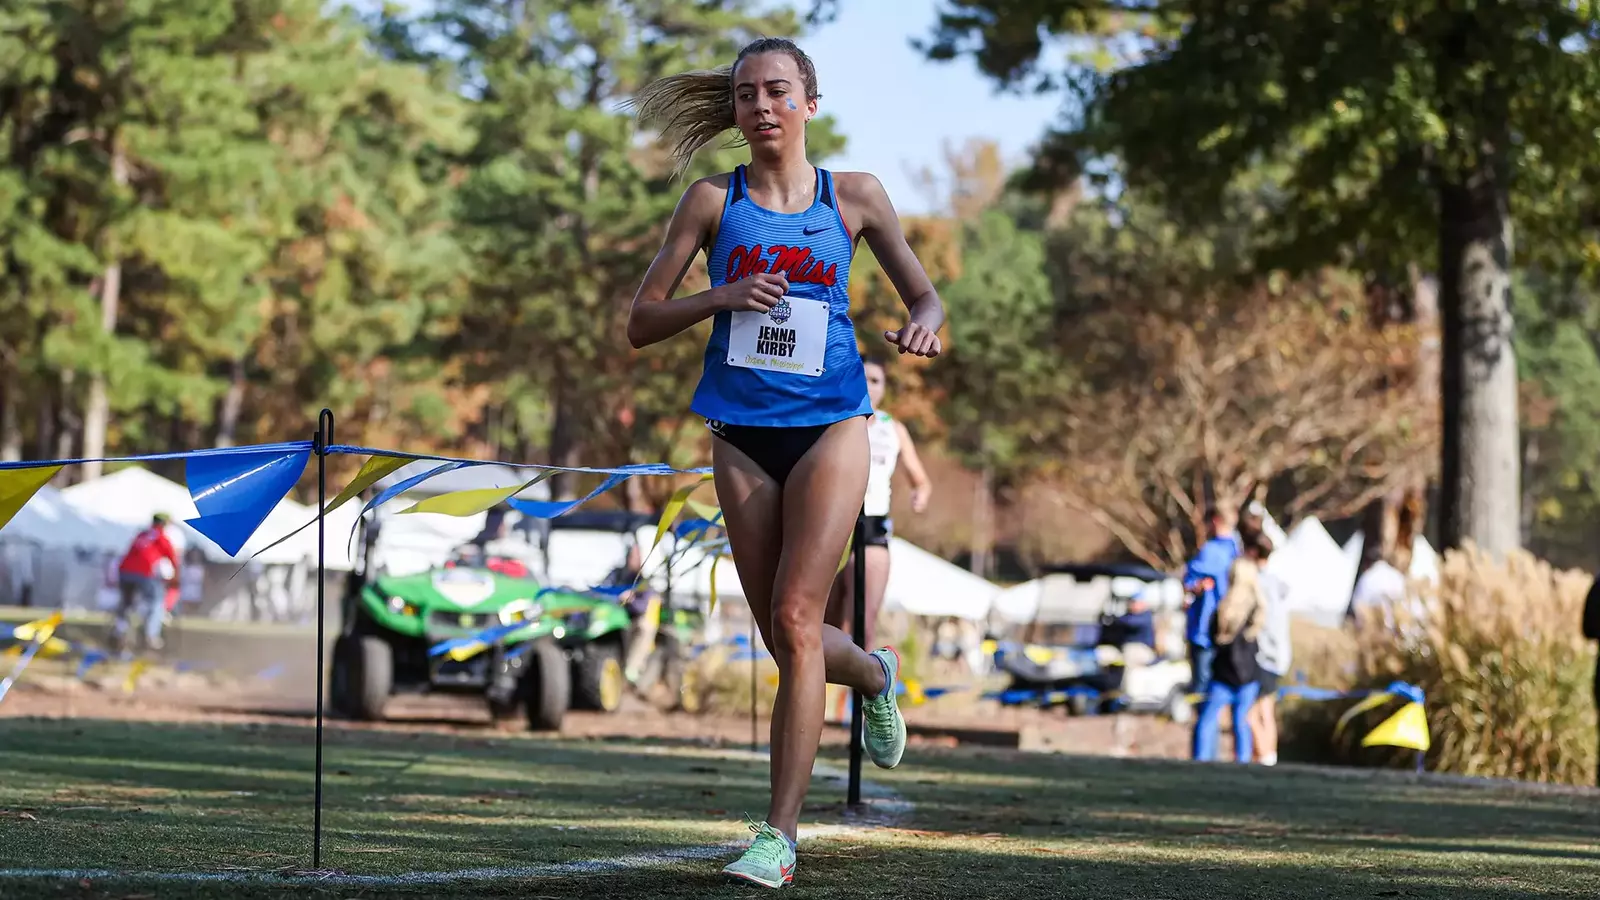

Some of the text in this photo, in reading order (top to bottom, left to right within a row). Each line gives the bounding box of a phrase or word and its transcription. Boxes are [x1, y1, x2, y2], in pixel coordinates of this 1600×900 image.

[726, 244, 838, 286] Ole Miss
[758, 326, 796, 343] JENNA
[757, 340, 796, 357] KIRBY
